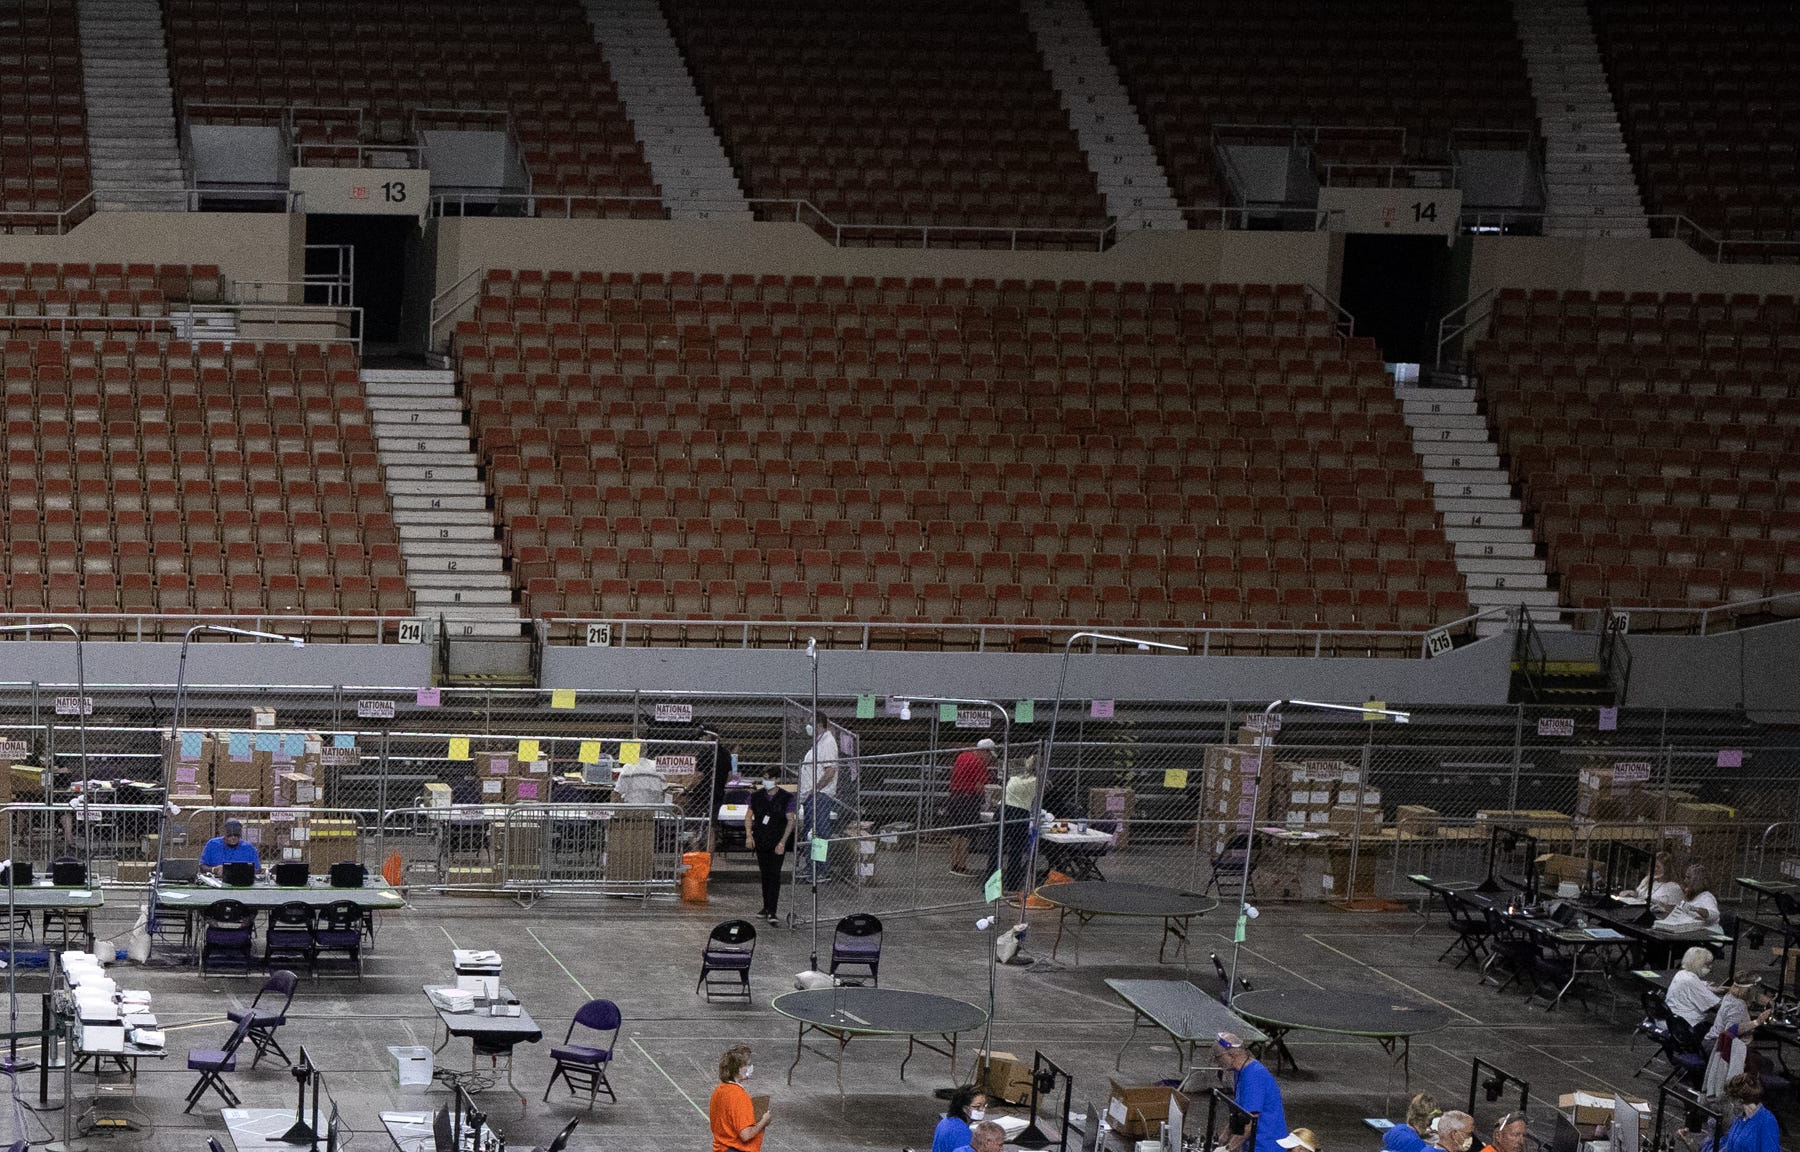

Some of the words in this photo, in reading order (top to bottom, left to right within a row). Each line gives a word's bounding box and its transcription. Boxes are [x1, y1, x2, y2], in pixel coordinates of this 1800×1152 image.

[381, 183, 406, 202] 13
[1411, 202, 1436, 221] 14
[1431, 404, 1440, 412] 18
[411, 414, 419, 422] 17
[1441, 431, 1450, 439] 17
[418, 442, 426, 450] 16
[1451, 458, 1460, 466] 16
[425, 470, 433, 478] 15
[1463, 487, 1472, 495] 15
[431, 500, 440, 508] 14
[1472, 516, 1481, 524] 14
[440, 529, 448, 538] 13
[1484, 546, 1493, 554] 13
[448, 561, 456, 570] 12
[1495, 578, 1505, 586] 12
[455, 593, 461, 601] 11
[401, 624, 419, 639] 214
[464, 626, 473, 634] 10
[589, 628, 607, 643] 215
[1431, 634, 1450, 652] 215
[57, 698, 91, 706] NATIOAL
[359, 701, 393, 709] NATIONAL
[656, 705, 691, 713] NATIONAL
[957, 711, 990, 719] NATIONAL
[1540, 719, 1574, 727] NATIONAL
[322, 748, 359, 756] NATIONAL
[656, 757, 694, 765] NATIONAL
[1306, 762, 1343, 770] NATIONAL
[1615, 763, 1649, 771] NATIONAL
